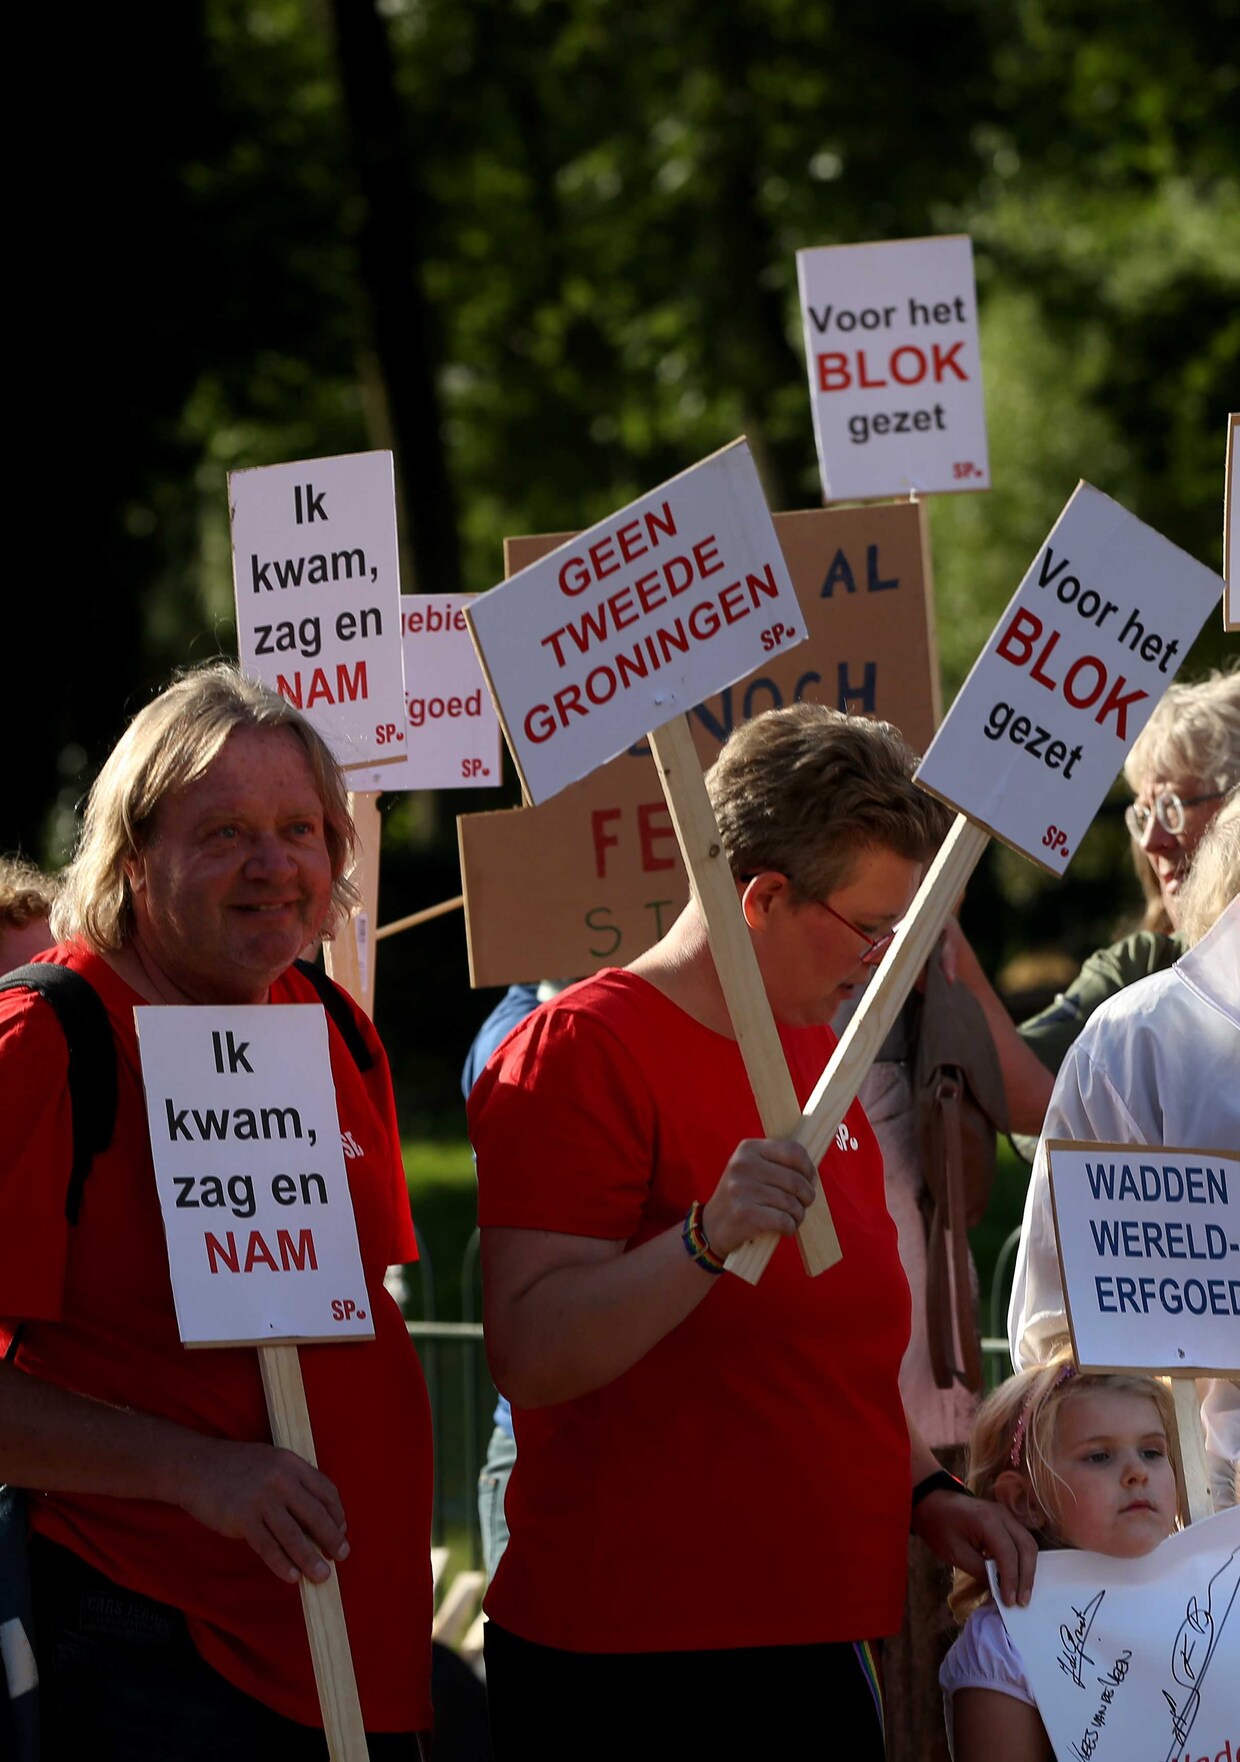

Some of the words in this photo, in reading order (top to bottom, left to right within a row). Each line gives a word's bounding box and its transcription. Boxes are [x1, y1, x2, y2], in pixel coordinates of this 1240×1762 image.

[808, 304, 897, 335] Voor
[908, 296, 967, 326] het
[816, 340, 969, 393] BLOK
[848, 403, 946, 444] gezet
[294, 484, 329, 525] Ik
[251, 548, 378, 594] kwam,
[558, 501, 678, 597] GEEN
[820, 544, 899, 599] AL
[401, 605, 468, 637] ebie
[541, 534, 725, 668] TWEEDE
[1038, 547, 1119, 628] Voor
[1117, 608, 1180, 674] het
[254, 616, 322, 658] zag
[335, 606, 382, 642] en
[524, 563, 779, 744] GRONINGEN
[276, 660, 369, 711] NAM
[995, 606, 1150, 742] BLOK
[405, 689, 482, 727] goed
[983, 701, 1083, 780] gezet
[211, 1031, 254, 1074] Ik
[164, 1098, 317, 1147] kwam,
[172, 1173, 257, 1219] zag
[271, 1172, 329, 1205] en
[1085, 1162, 1229, 1205] WADDEN
[204, 1228, 318, 1275] NAM
[1089, 1219, 1240, 1261] WERELD-
